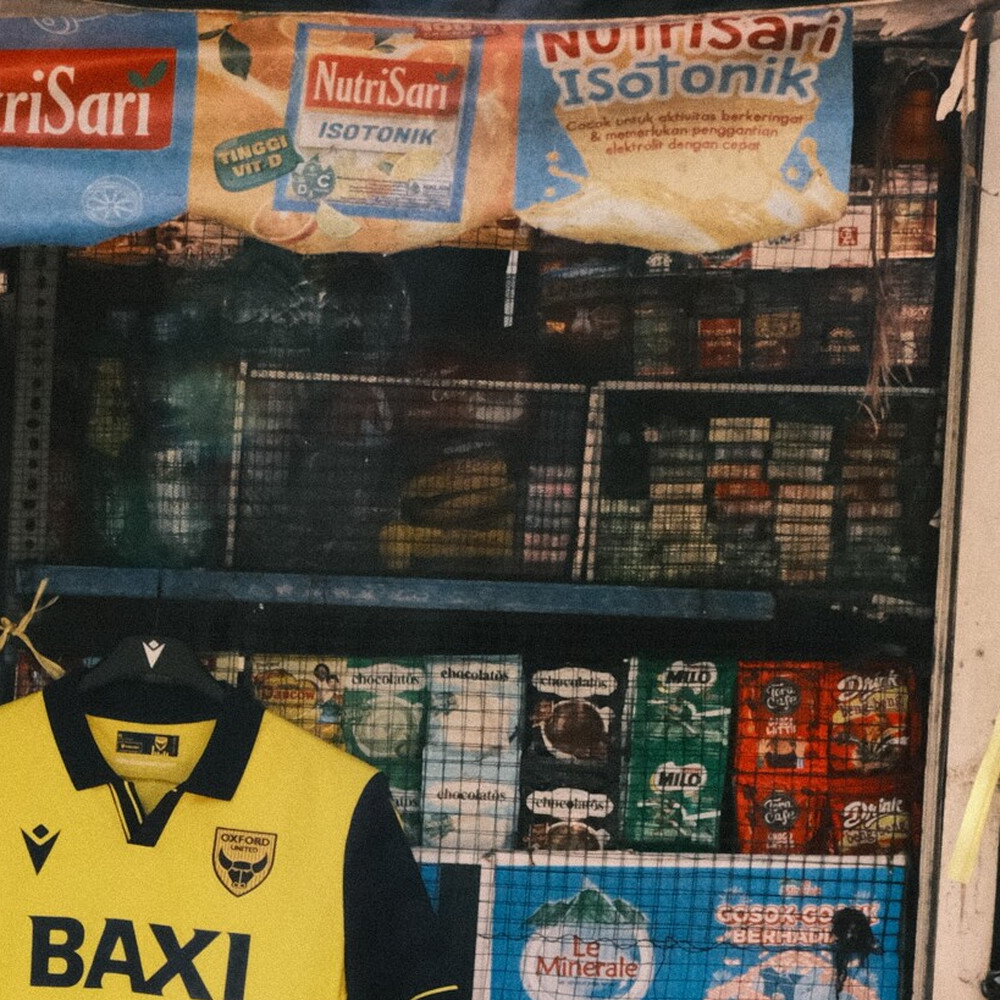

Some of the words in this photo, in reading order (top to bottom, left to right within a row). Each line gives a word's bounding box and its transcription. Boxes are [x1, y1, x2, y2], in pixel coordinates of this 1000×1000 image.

[313, 60, 448, 110] NutriSari
[565, 117, 612, 131] Cocok
[615, 113, 653, 127] untuk
[658, 111, 717, 124] aktivitas
[721, 110, 804, 127] berkeringat
[318, 121, 437, 145] ISOTONIK
[590, 130, 601, 141] &
[605, 126, 688, 141] memerlukan
[692, 124, 778, 139] penggantian
[218, 135, 288, 165] TINGGI
[606, 140, 663, 155] elektrolit
[668, 138, 718, 153] dengan
[722, 138, 761, 153] cepat
[231, 157, 264, 178] VIT
[268, 154, 283, 169] D
[665, 671, 711, 684] MILO
[658, 772, 701, 787] MILO
[221, 833, 270, 847] OXFORD
[230, 845, 258, 853] UNITED
[573, 935, 600, 957] Le
[536, 956, 639, 978] Minerale
